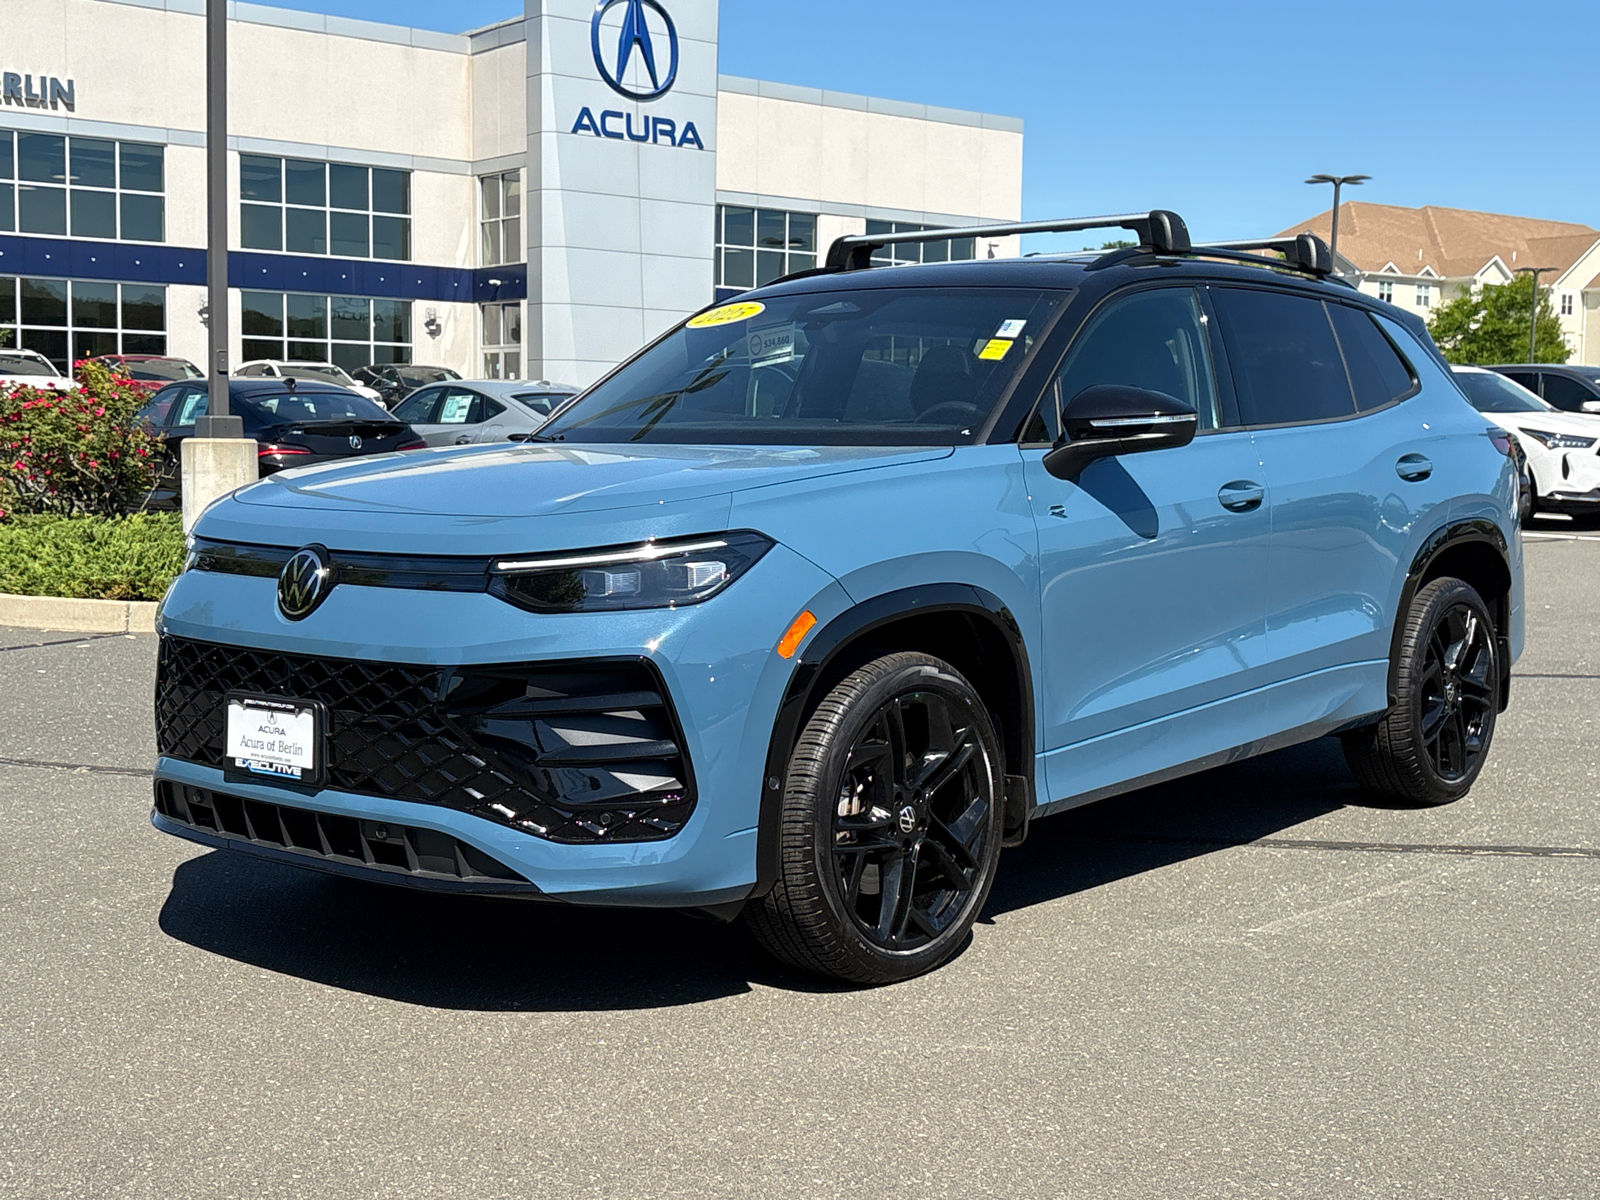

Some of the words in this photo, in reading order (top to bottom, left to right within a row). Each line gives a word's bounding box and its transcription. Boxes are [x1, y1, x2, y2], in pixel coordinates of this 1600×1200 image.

[0, 71, 75, 108] RLIN
[571, 106, 704, 150] ACURA
[258, 725, 286, 736] ACURA
[239, 735, 264, 750] Acura
[266, 740, 276, 752] of
[278, 740, 303, 756] Berlin
[235, 757, 301, 776] EXECUTIVE
